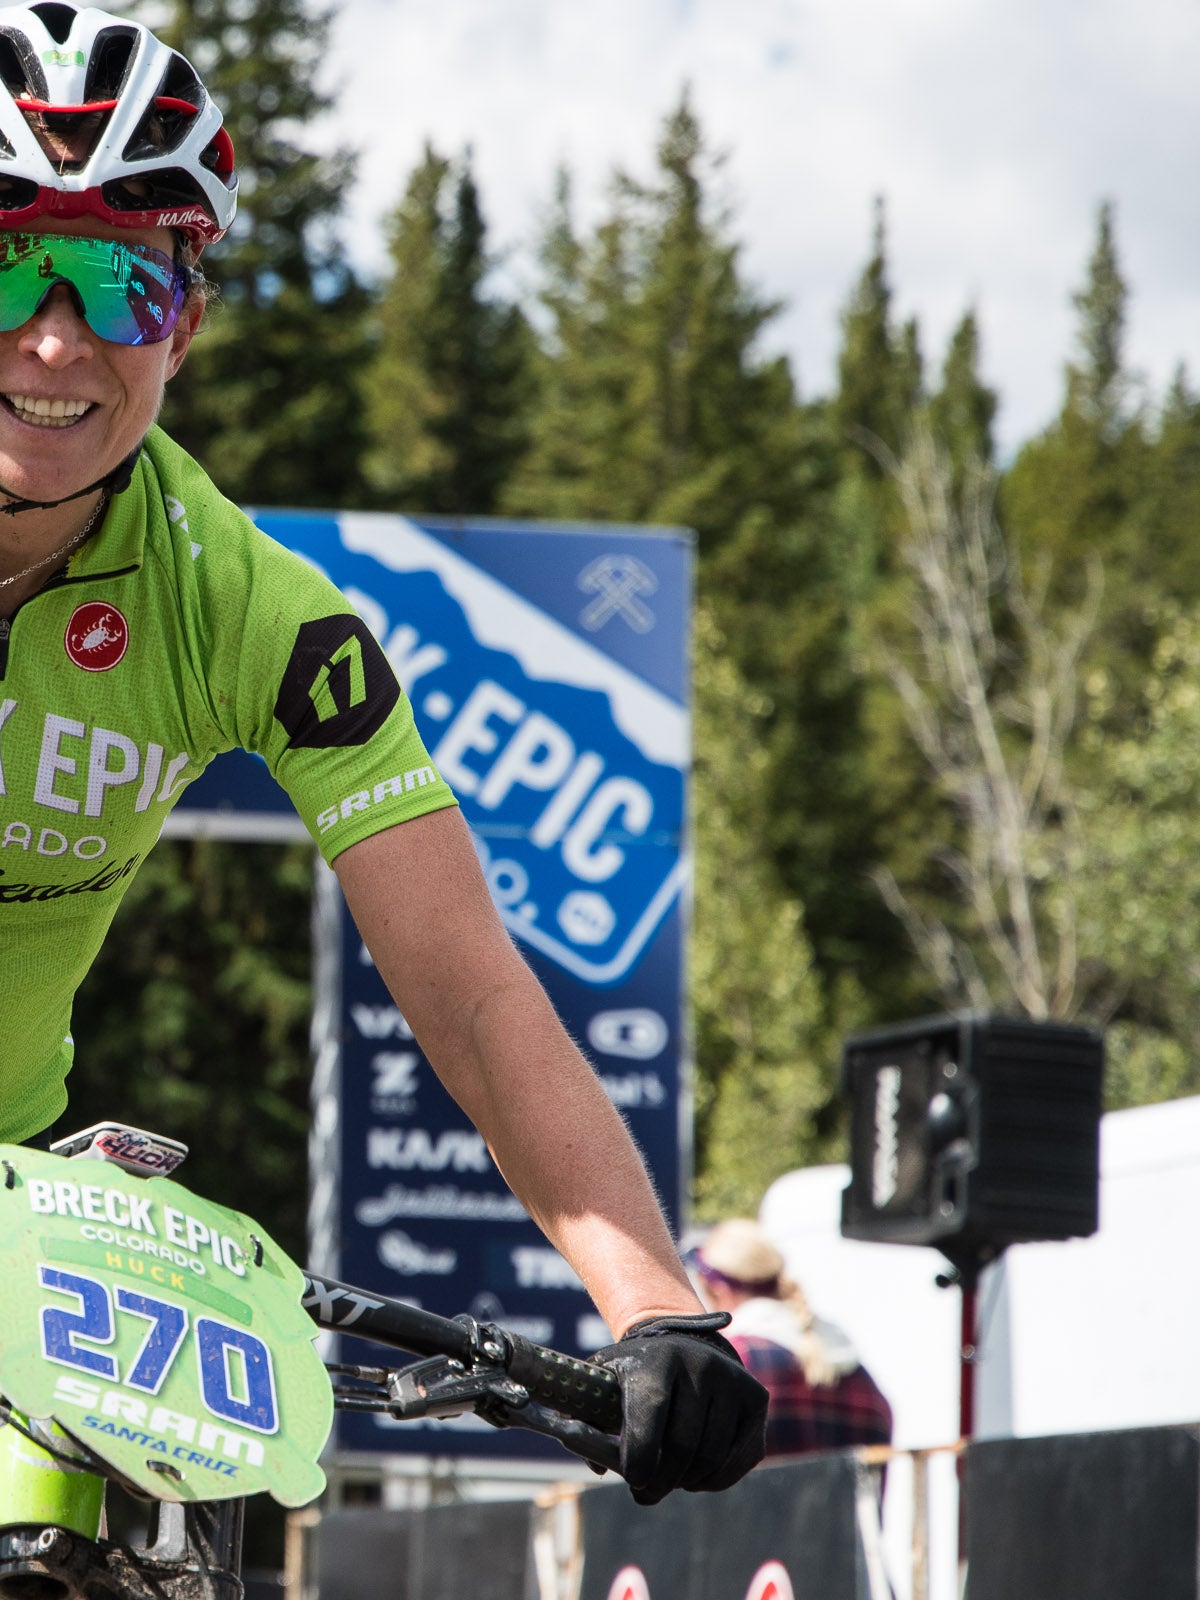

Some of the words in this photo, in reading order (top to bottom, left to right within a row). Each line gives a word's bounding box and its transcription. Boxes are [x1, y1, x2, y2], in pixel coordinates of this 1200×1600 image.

[316, 765, 436, 834] SRAM
[27, 1178, 157, 1236] BRECK
[164, 1205, 247, 1278] EPIC
[80, 1224, 207, 1276] COLORADO
[105, 1251, 186, 1291] HUCK
[38, 1263, 280, 1436] 270
[53, 1376, 264, 1467] SRAM
[81, 1415, 169, 1454] SANTA
[172, 1445, 239, 1478] CRUZ
